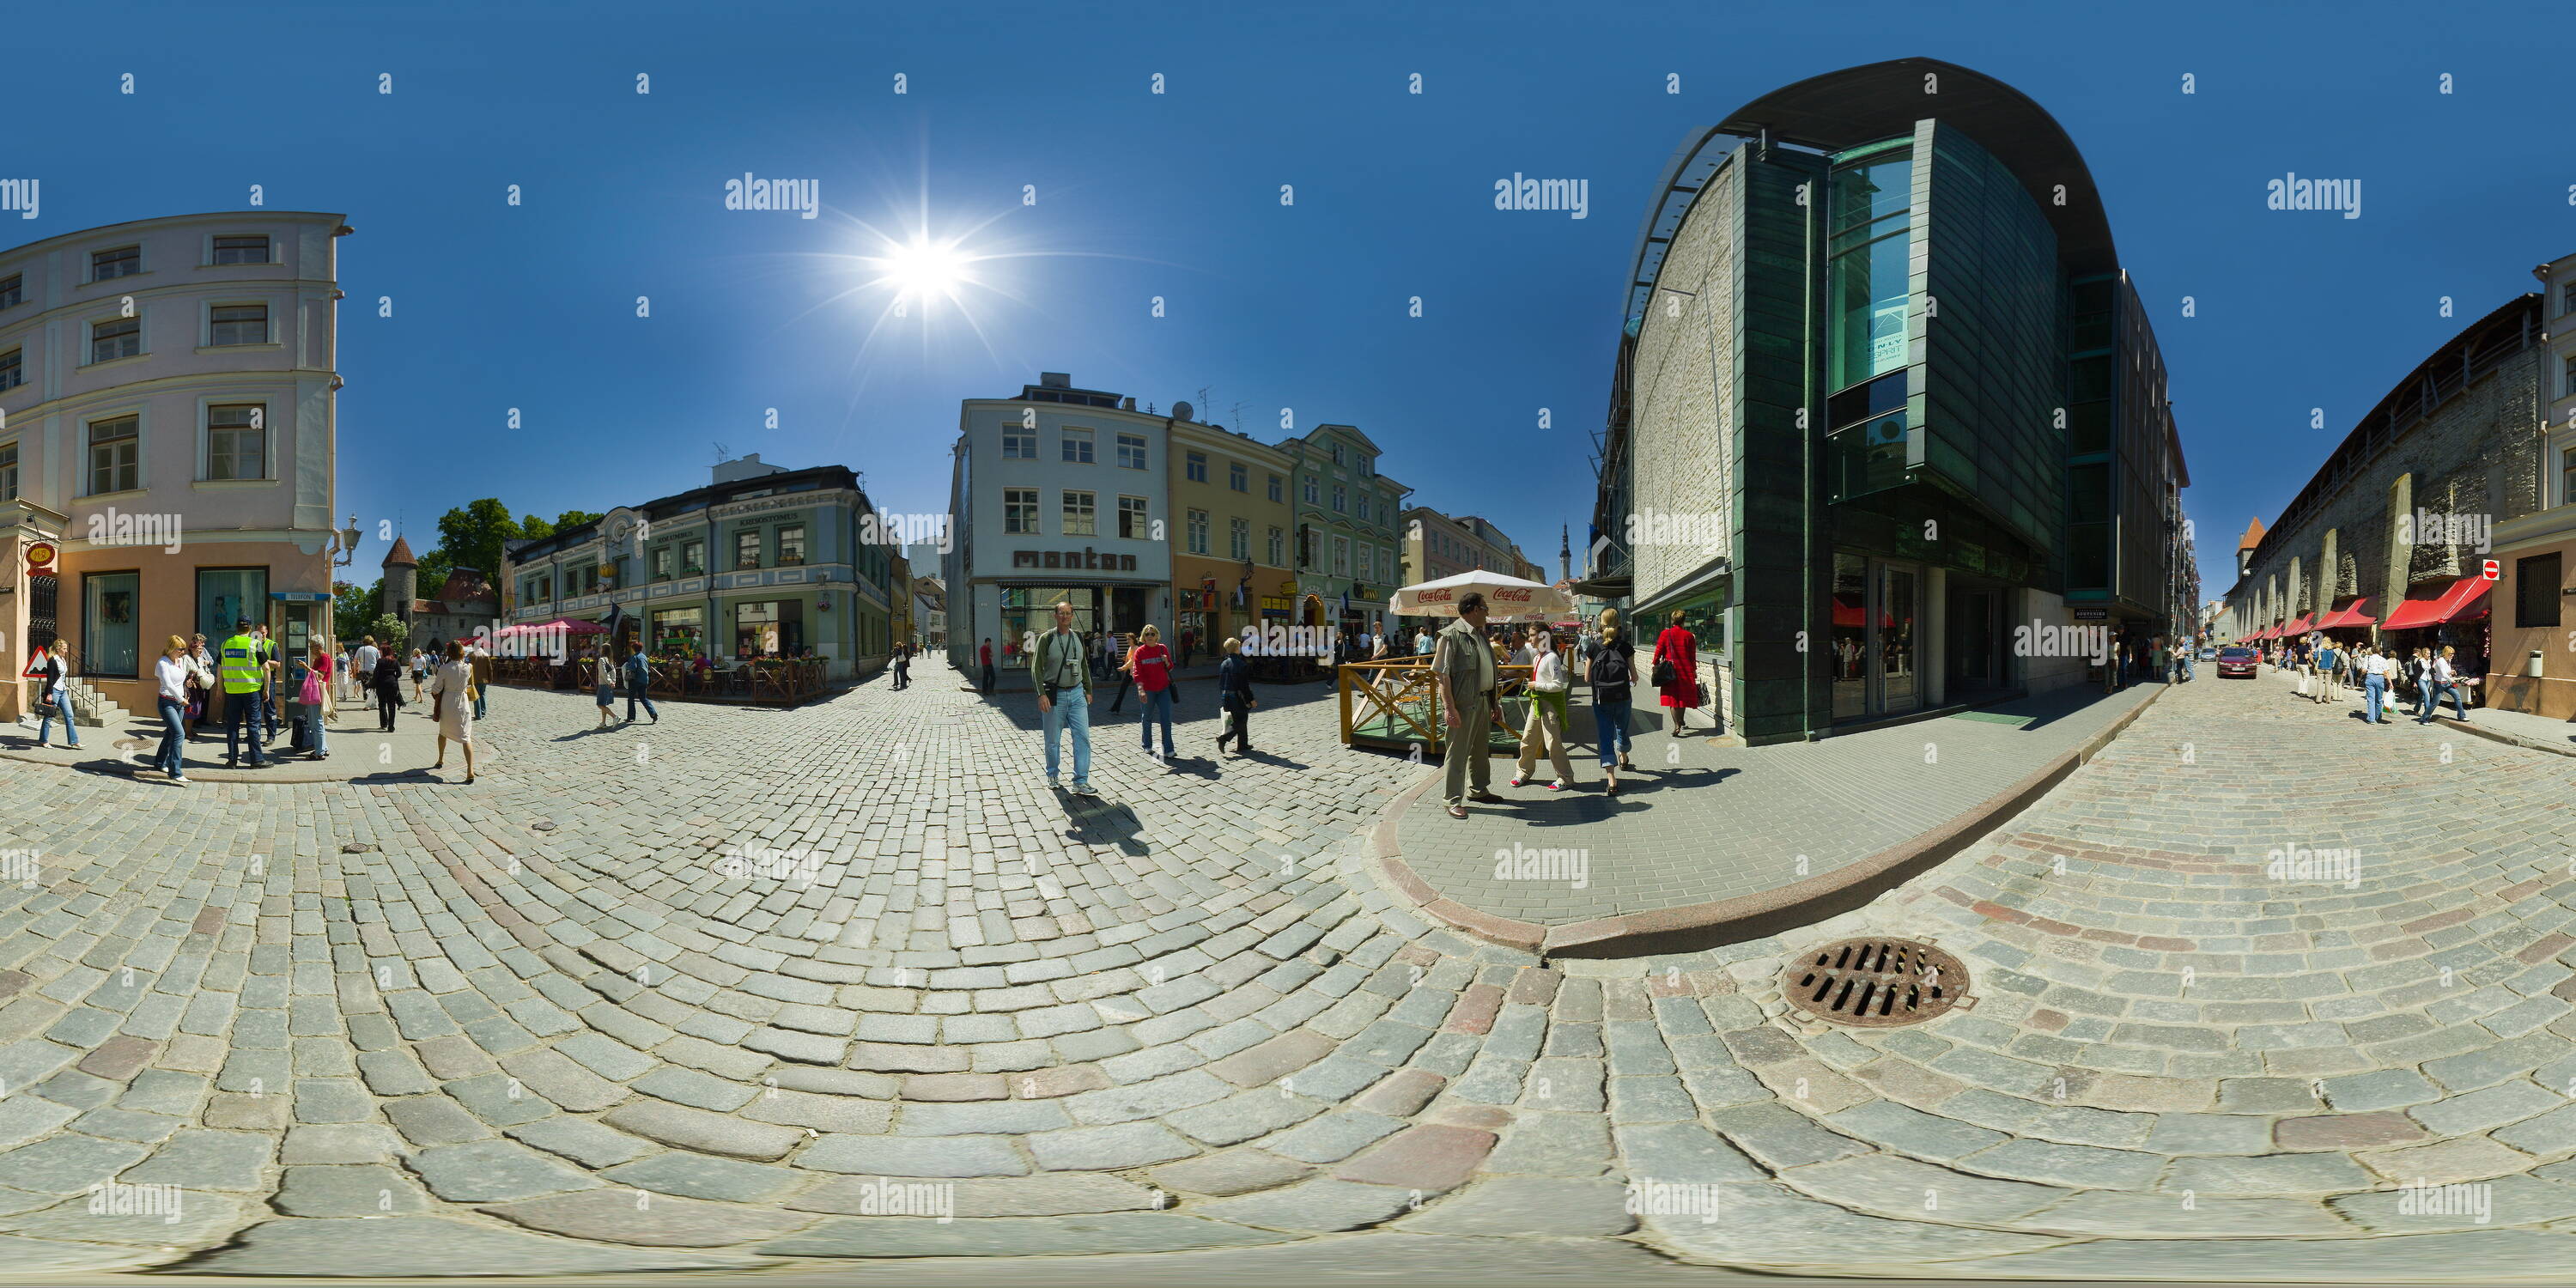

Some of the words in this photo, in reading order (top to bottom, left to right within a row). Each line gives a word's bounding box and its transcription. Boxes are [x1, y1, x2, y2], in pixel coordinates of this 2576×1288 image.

[739, 513, 798, 526] KRISOSTOMUS
[658, 531, 693, 544] KOLUMBUS
[1013, 546, 1136, 571] monton
[1418, 588, 1452, 603] Coca-Cola
[1493, 587, 1533, 601] Coca-Cola
